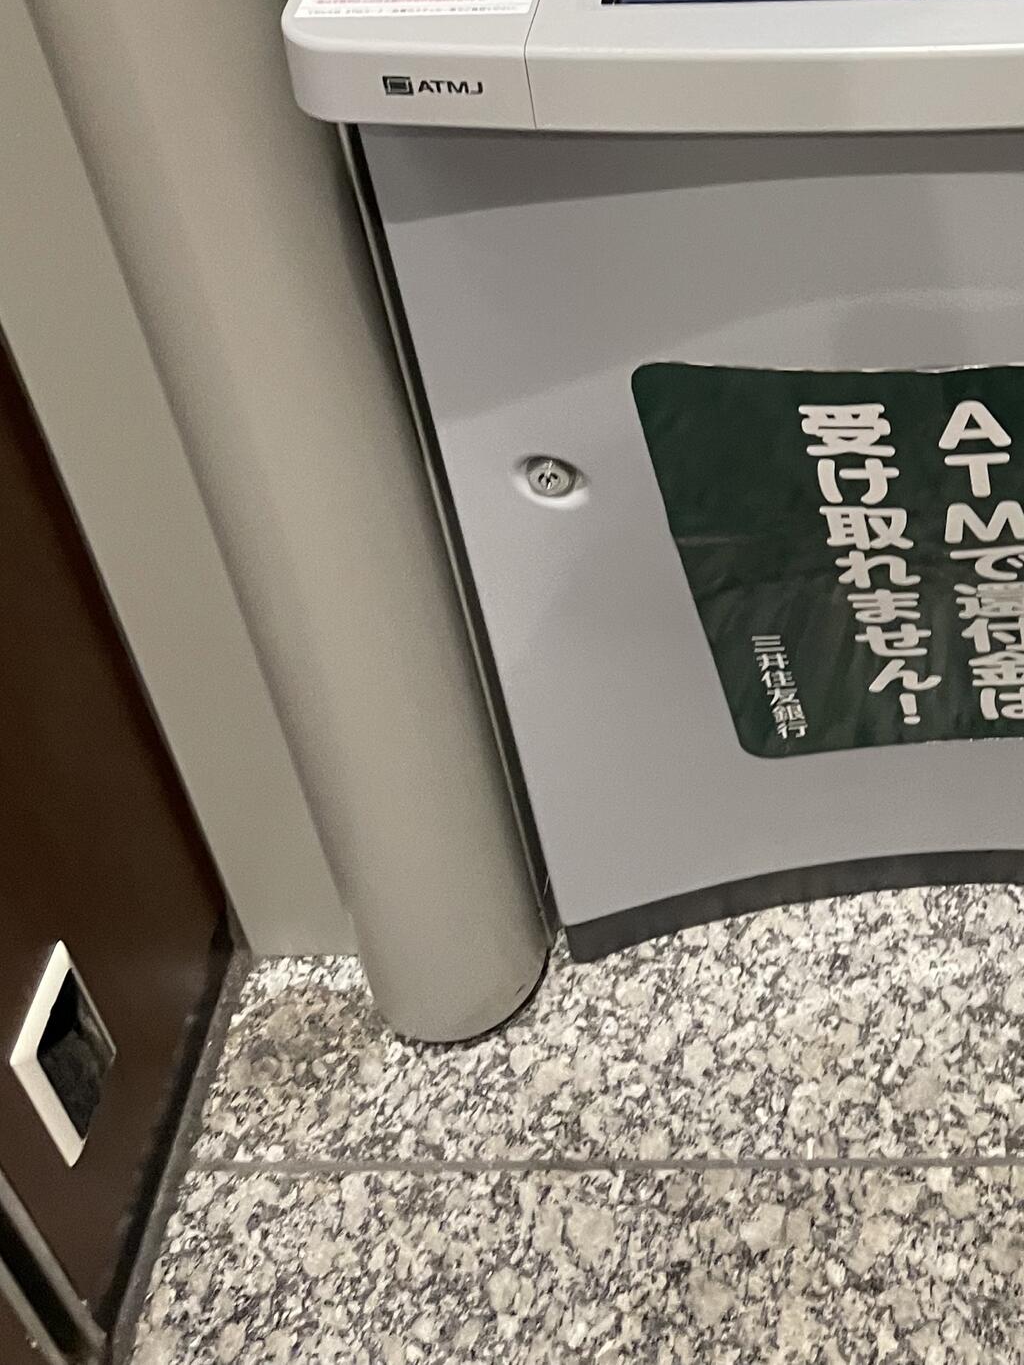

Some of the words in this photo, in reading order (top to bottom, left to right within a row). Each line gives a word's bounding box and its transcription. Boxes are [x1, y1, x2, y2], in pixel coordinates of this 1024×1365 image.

[798, 402, 942, 724] 受け取れません!
[751, 635, 808, 739] 三井住友銀行
